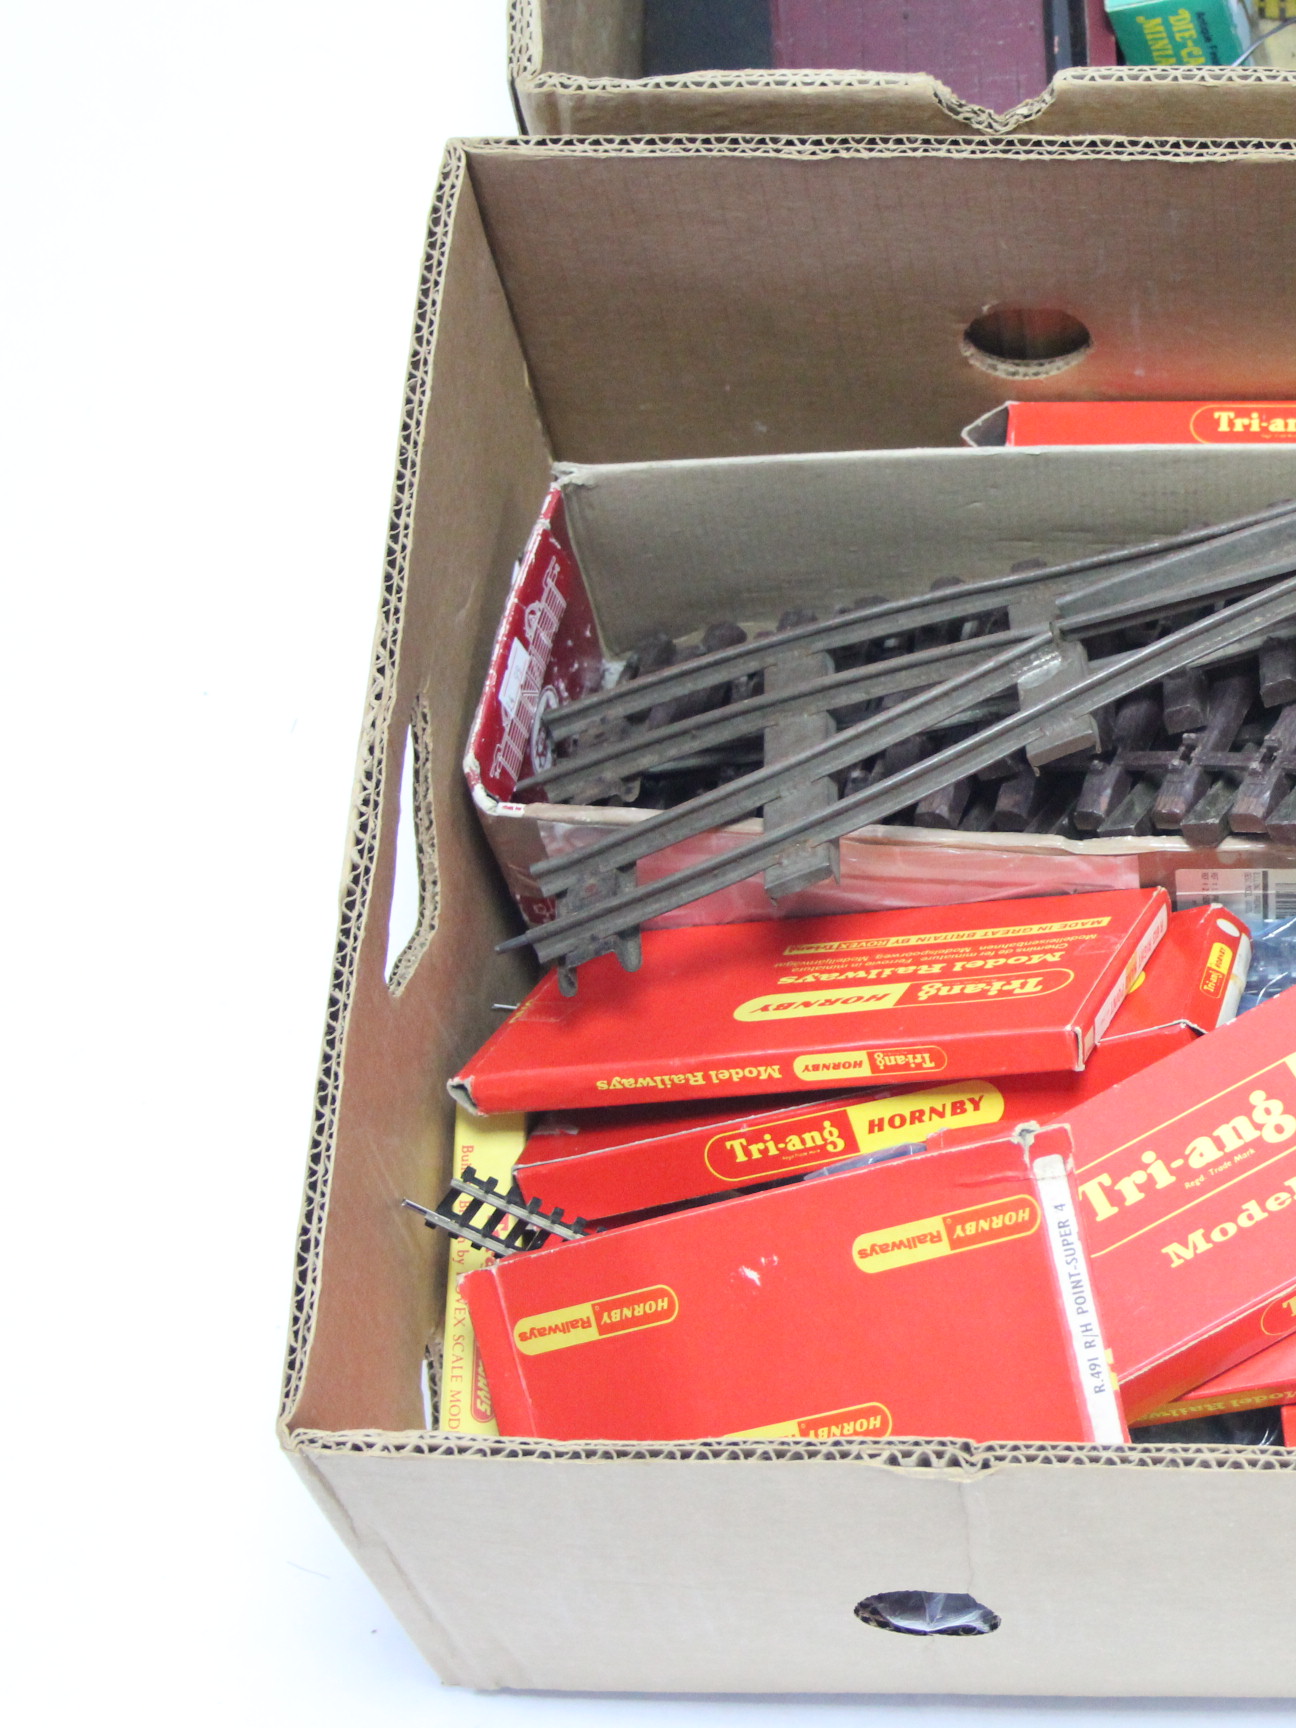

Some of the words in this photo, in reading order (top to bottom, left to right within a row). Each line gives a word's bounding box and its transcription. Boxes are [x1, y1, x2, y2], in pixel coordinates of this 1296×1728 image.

[1136, 16, 1176, 65] MINIA
[1168, 8, 1206, 65] DIE-CA
[981, 926, 1034, 937] GREAT
[1038, 924, 1054, 932] IN
[1057, 919, 1103, 929] MADE
[890, 937, 912, 945] BY
[915, 932, 976, 943] BRITAIN
[1016, 943, 1069, 953] Chemins
[952, 951, 1066, 972] Model
[777, 963, 947, 984] Railways
[917, 977, 1044, 1001] Tri-ang
[749, 993, 892, 1014] HORNBY
[802, 1059, 863, 1072] HORNBY
[874, 1050, 936, 1070] Tri-ang
[596, 1072, 704, 1091] Railways
[713, 1065, 783, 1084] Model
[725, 1120, 845, 1162] Tri-ang
[867, 1095, 985, 1135] HORNBY
[461, 1145, 475, 1168] Bui
[1208, 1161, 1232, 1179] Trade
[1233, 1147, 1256, 1167] Mark
[1053, 1203, 1067, 1212] 4
[952, 1207, 1031, 1239] HORNBY
[857, 1229, 943, 1260] Railways
[452, 1250, 464, 1272] by
[1057, 1219, 1089, 1316] POINT-SUPER
[600, 1297, 669, 1325] HORNBY
[518, 1315, 593, 1342] Railways
[1080, 1322, 1100, 1350] R/H
[449, 1334, 465, 1383] SCALE
[1087, 1357, 1106, 1394] R.491
[447, 1389, 462, 1432] MOD
[1143, 1402, 1227, 1421] Railw
